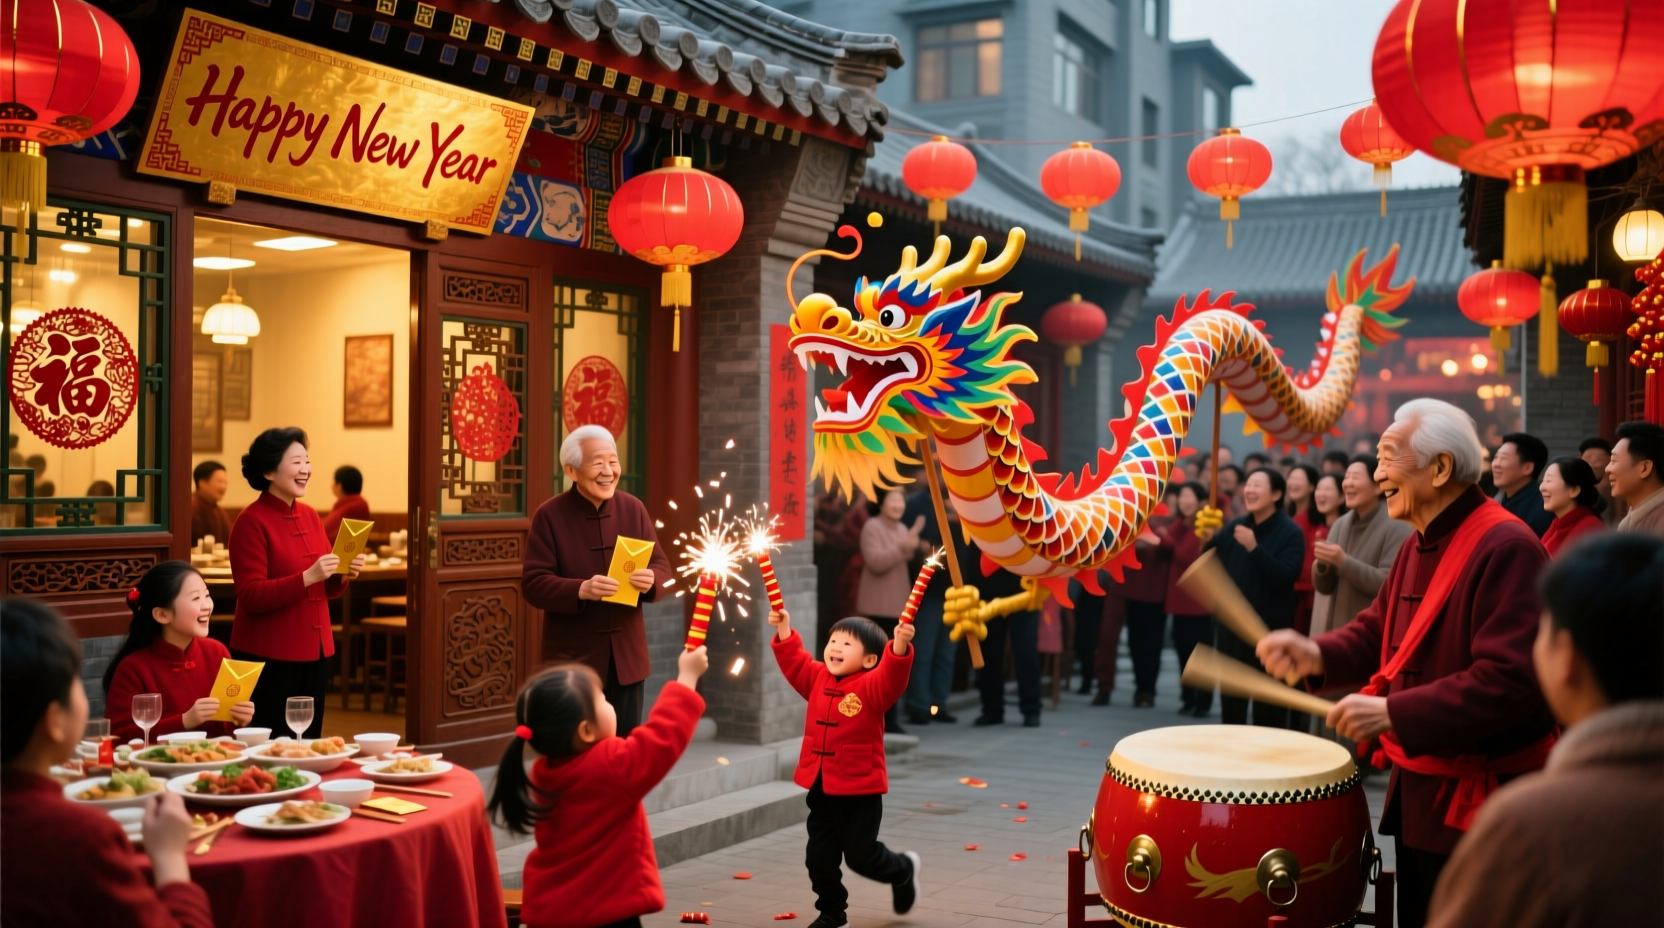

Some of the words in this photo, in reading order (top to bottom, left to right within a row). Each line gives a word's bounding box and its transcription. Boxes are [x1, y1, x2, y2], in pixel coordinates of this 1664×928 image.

[185, 63, 330, 167] Happy
[330, 102, 421, 169] New
[421, 121, 498, 189] Year
[29, 333, 111, 418] 福
[572, 366, 617, 428] 福
